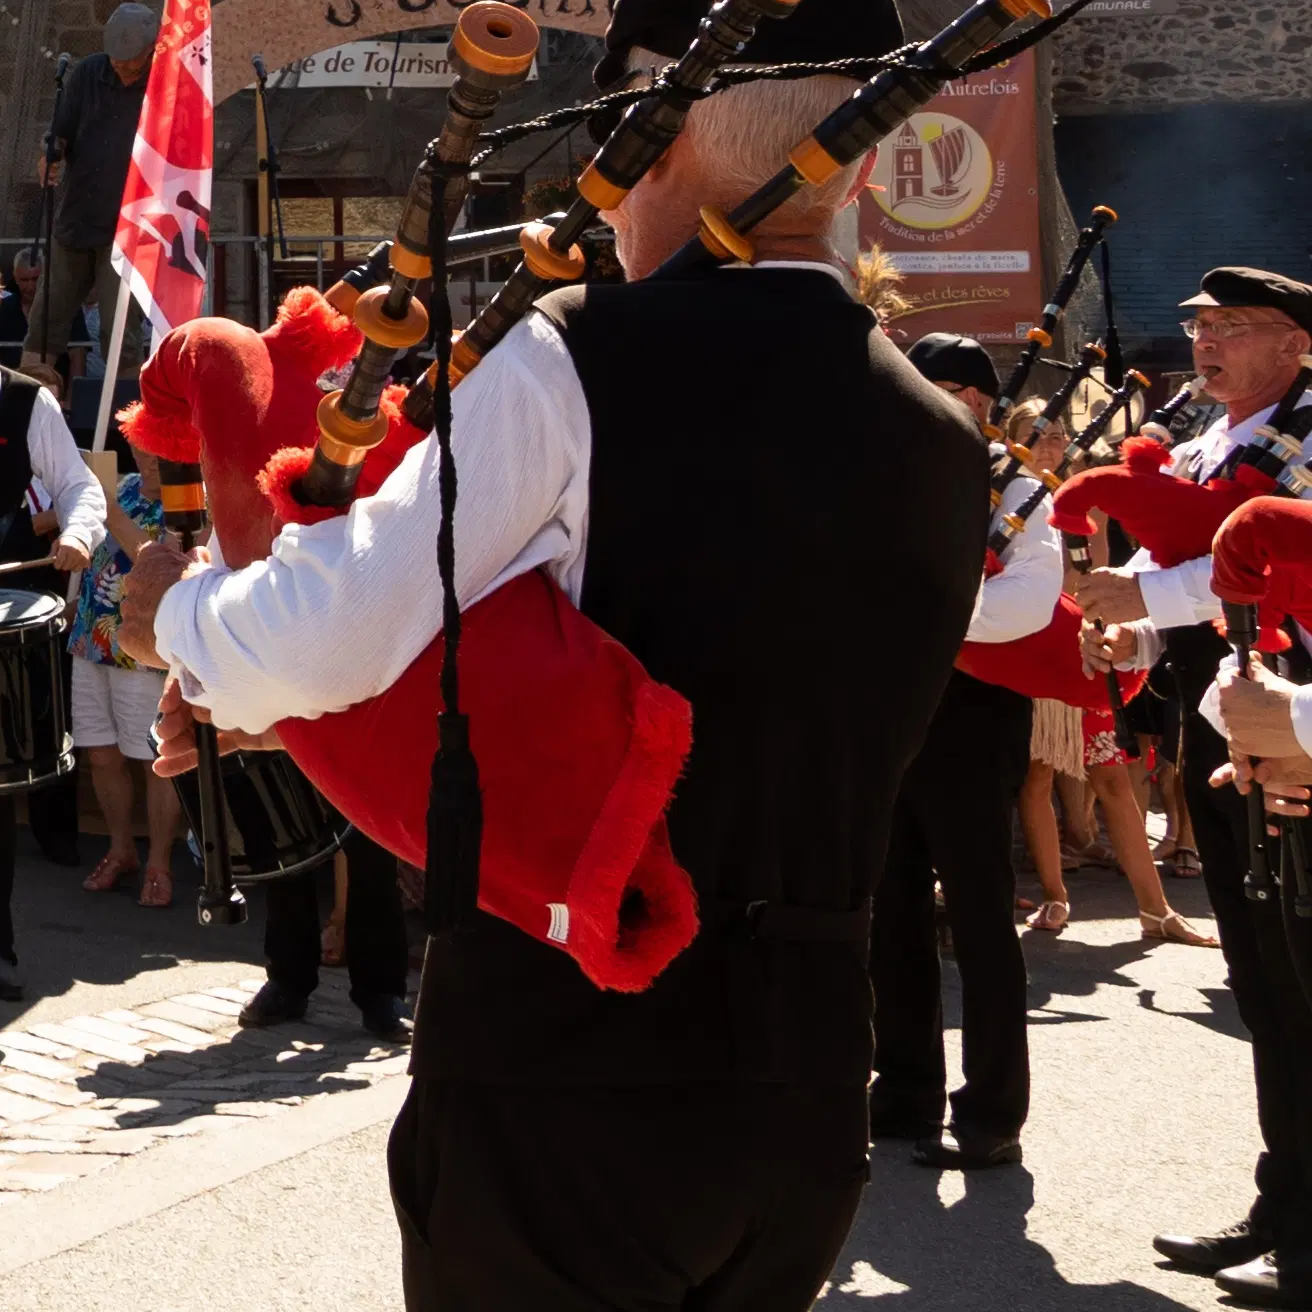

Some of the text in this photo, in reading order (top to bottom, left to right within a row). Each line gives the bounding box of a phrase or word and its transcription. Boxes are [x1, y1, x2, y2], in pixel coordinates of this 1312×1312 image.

[323, 50, 356, 74] de
[363, 51, 458, 75] Tourism
[941, 78, 1020, 96] Autrefois
[940, 285, 969, 300] des
[971, 285, 1011, 299] rêves
